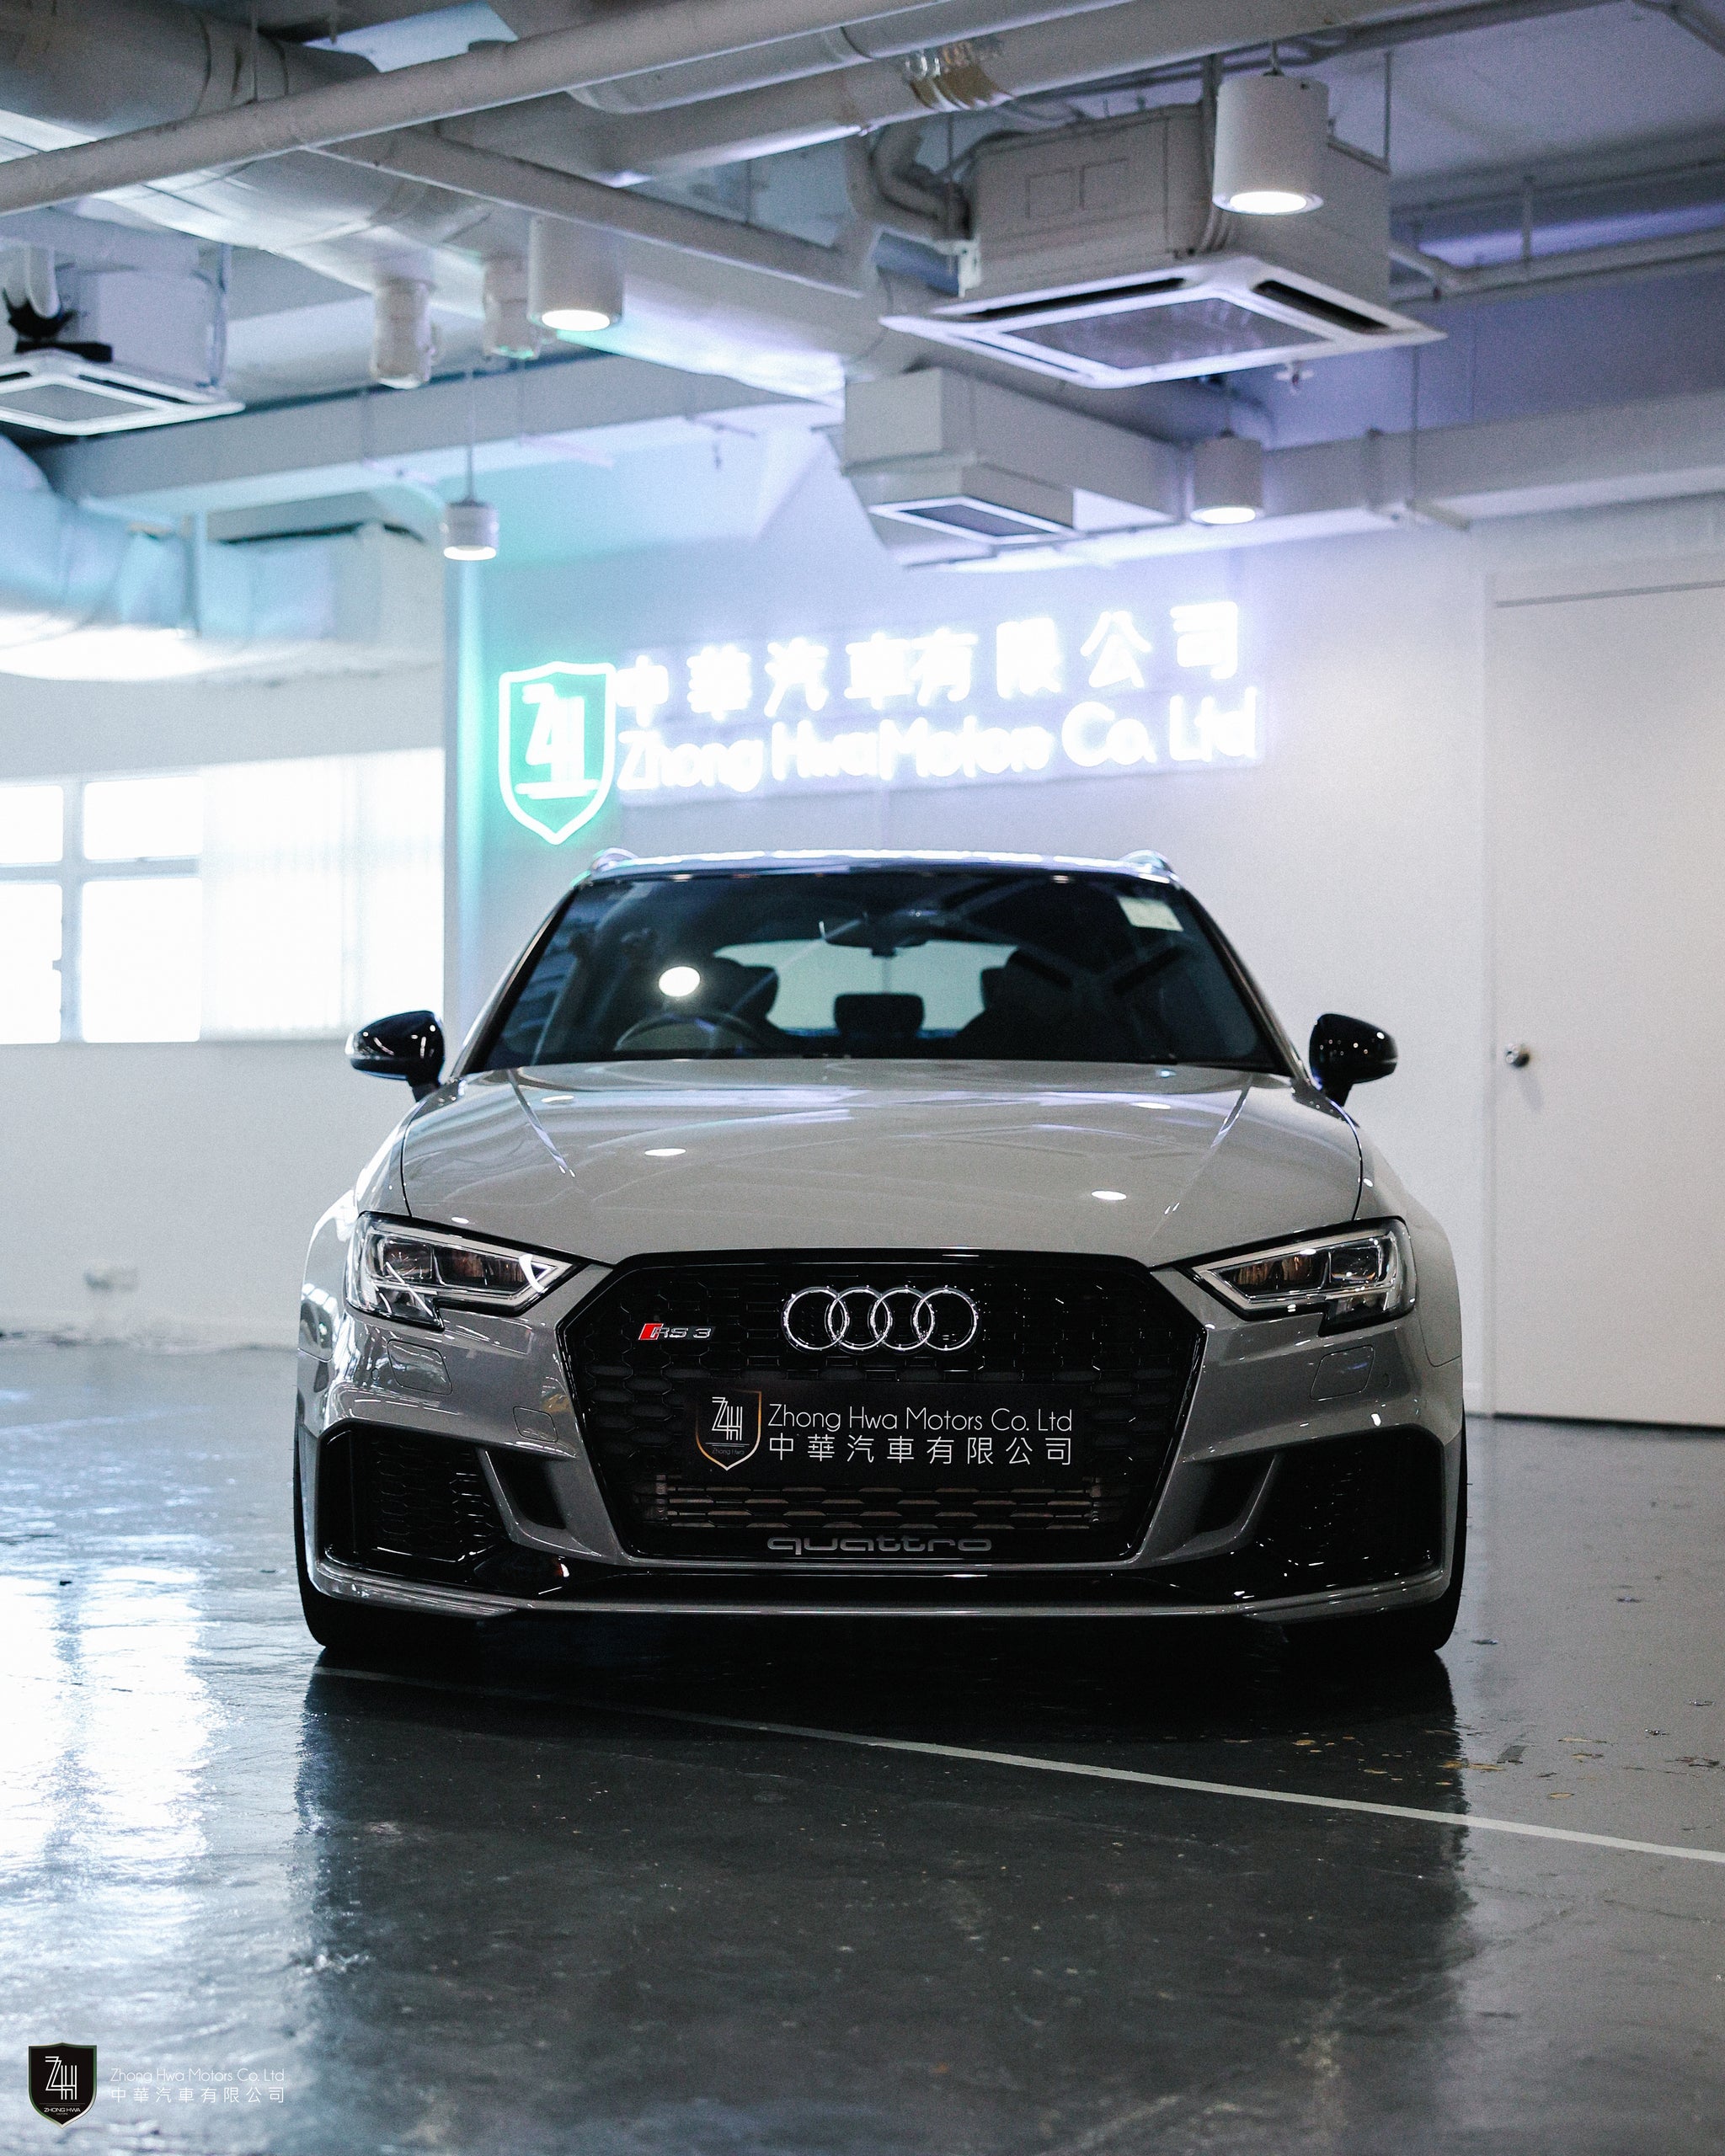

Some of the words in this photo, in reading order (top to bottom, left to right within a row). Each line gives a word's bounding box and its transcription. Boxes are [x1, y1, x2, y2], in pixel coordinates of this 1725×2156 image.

[1169, 686, 1258, 762] Ltd
[649, 1326, 689, 1338] RS
[692, 1327, 712, 1338] 3
[768, 1403, 841, 1432] Zhong
[849, 1406, 898, 1429] Hwa
[905, 1406, 983, 1431] Motors
[991, 1407, 1030, 1431] Co.
[1038, 1408, 1072, 1432] Ltd
[768, 1432, 1072, 1465] 中華汽車有限公司
[766, 1534, 993, 1556] quattro
